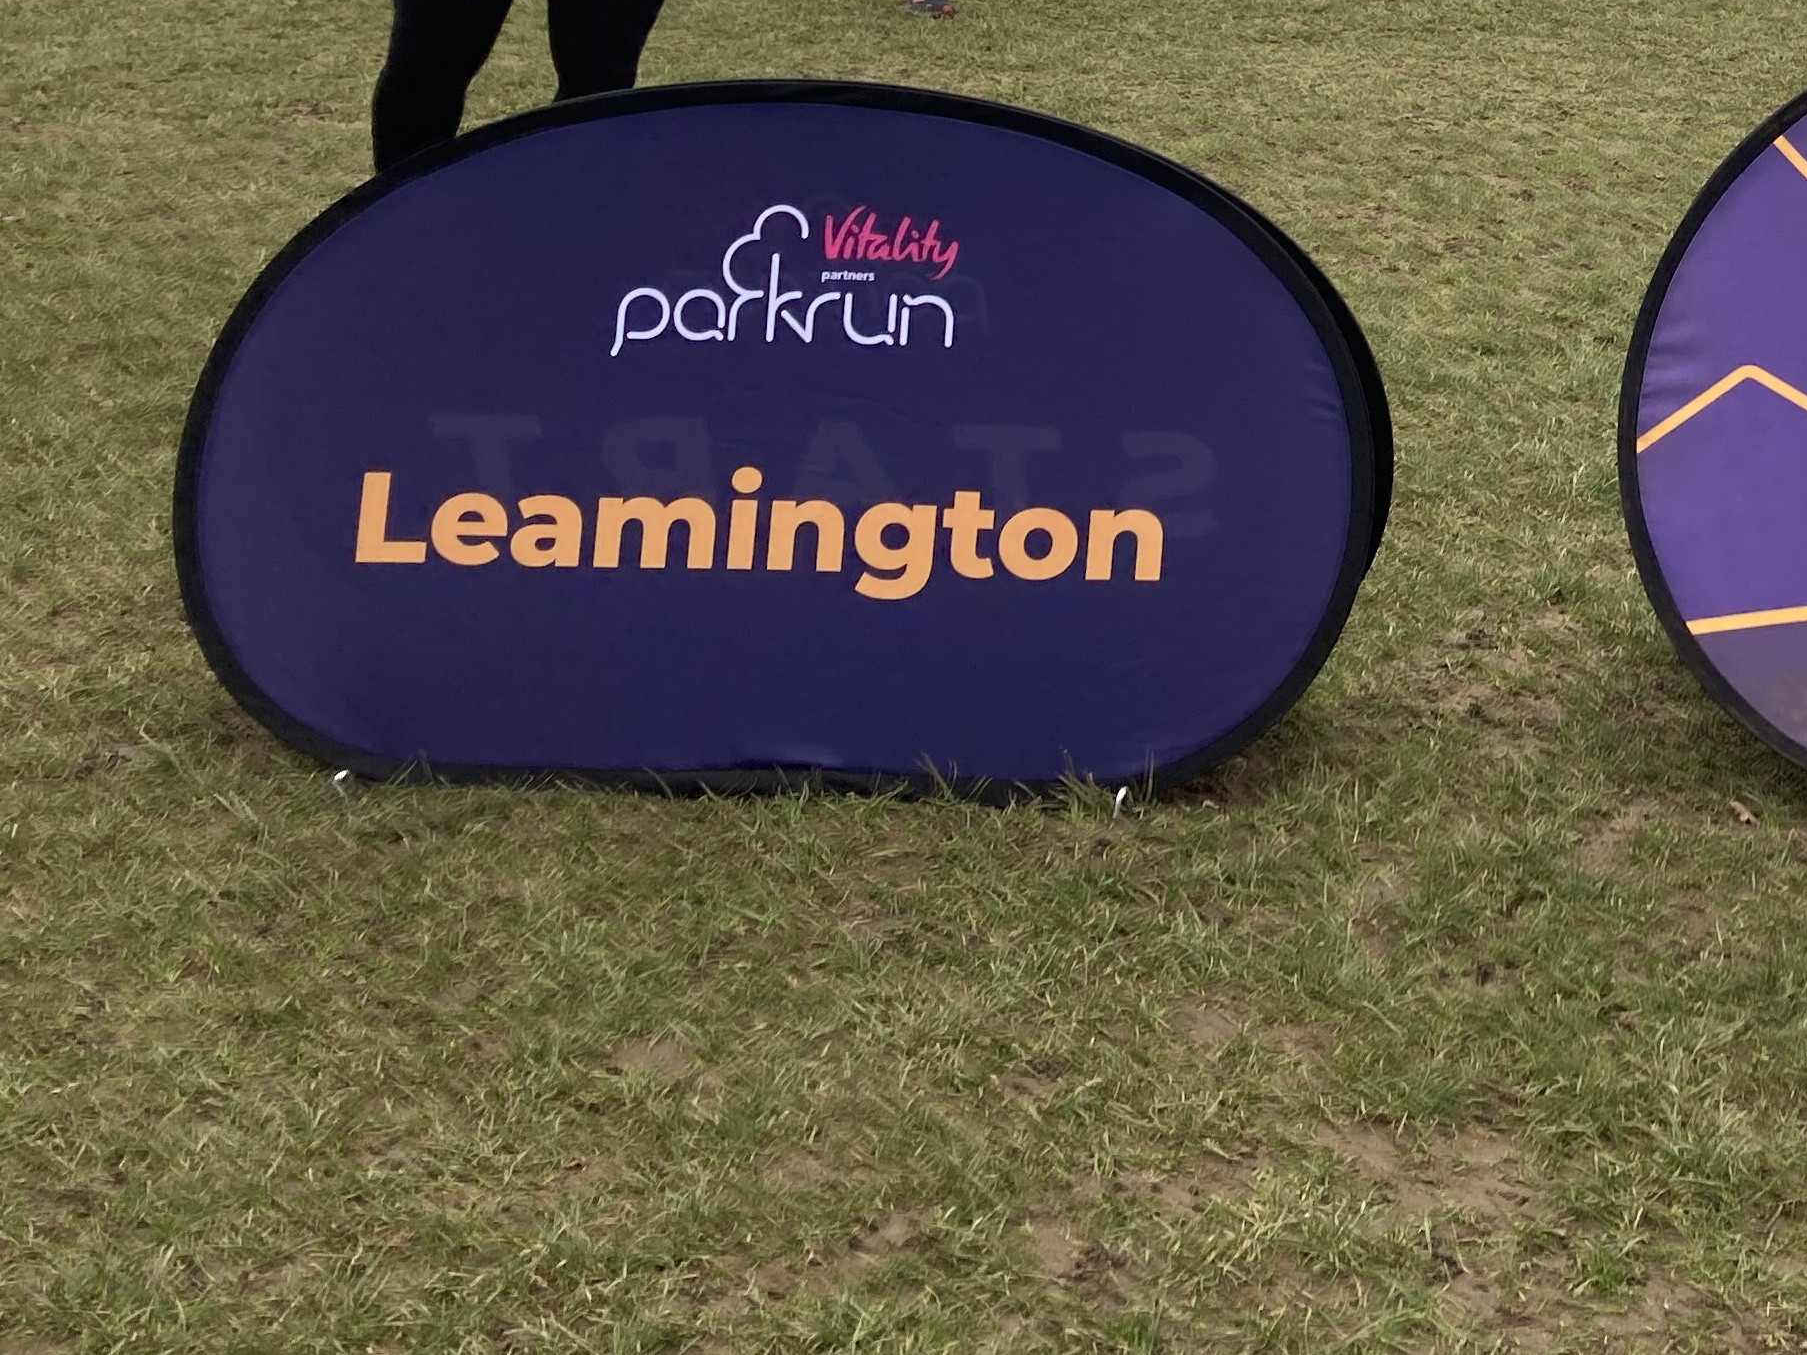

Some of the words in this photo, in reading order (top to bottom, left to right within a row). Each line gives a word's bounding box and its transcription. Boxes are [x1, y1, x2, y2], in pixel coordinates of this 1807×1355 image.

[821, 269, 876, 283] partners
[824, 204, 959, 280] Vitality
[609, 252, 955, 357] parkrun
[354, 466, 1165, 600] Leamington
